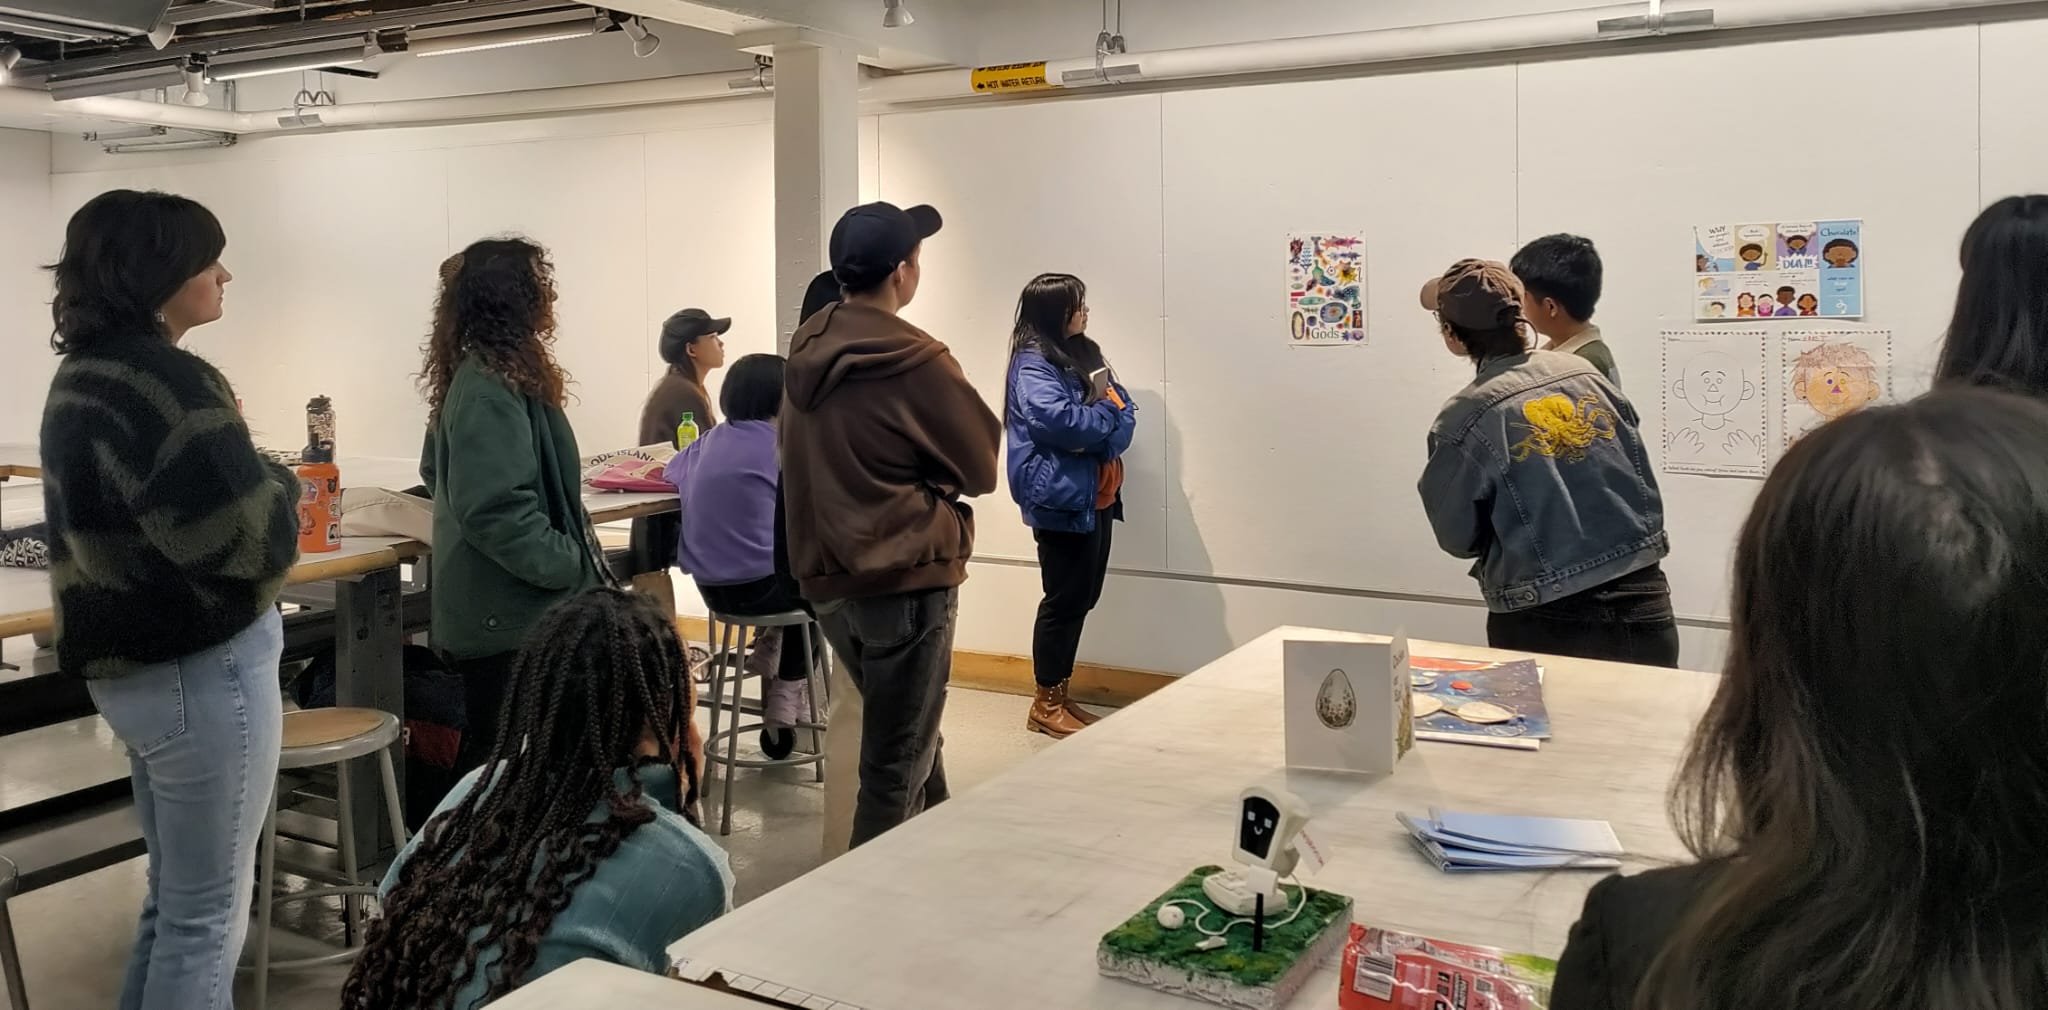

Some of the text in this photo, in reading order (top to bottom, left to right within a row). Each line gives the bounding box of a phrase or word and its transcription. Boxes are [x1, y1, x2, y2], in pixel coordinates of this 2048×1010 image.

[986, 80, 999, 89] HOT
[1001, 78, 1020, 87] WATER
[1311, 327, 1340, 340] Gods
[590, 453, 614, 466] ODE
